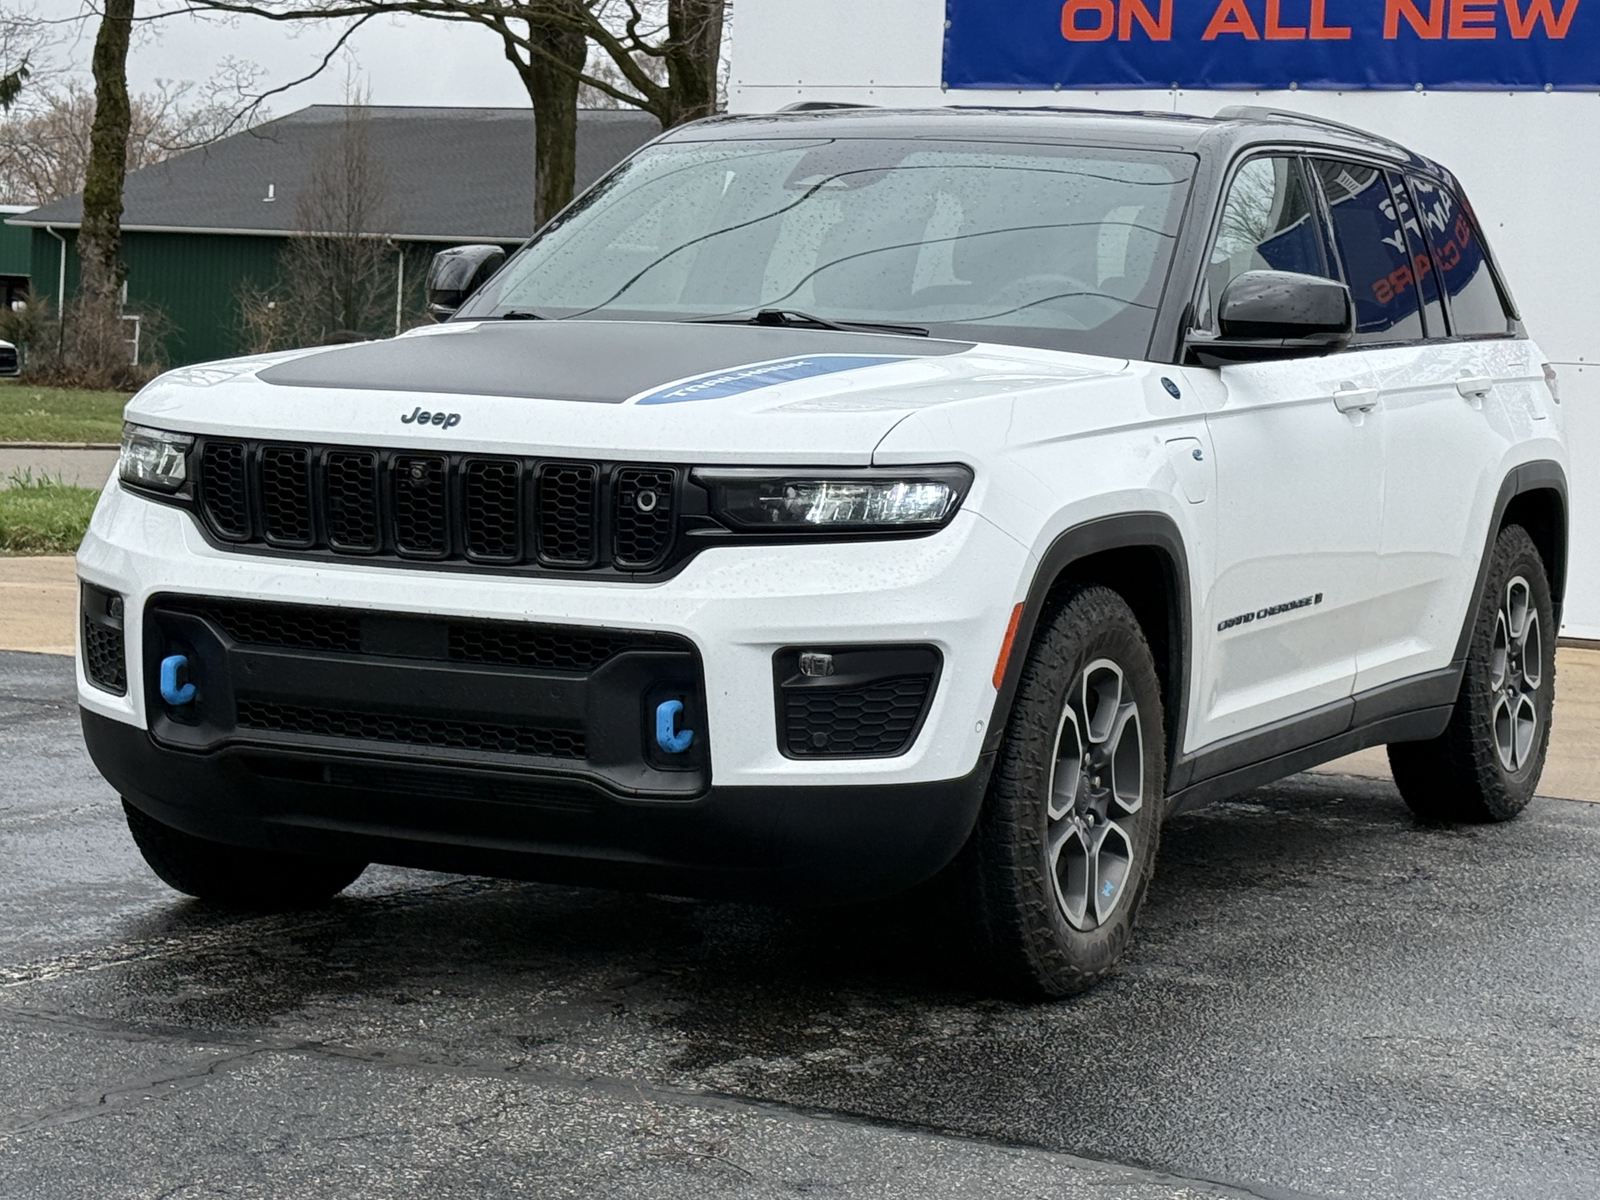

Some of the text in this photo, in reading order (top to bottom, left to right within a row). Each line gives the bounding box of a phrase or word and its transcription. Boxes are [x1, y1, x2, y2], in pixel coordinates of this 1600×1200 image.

[1061, 0, 1579, 41] ON ALL NEW
[400, 406, 462, 430] Jeep
[1217, 595, 1314, 632] GRAND CHEROKEE
